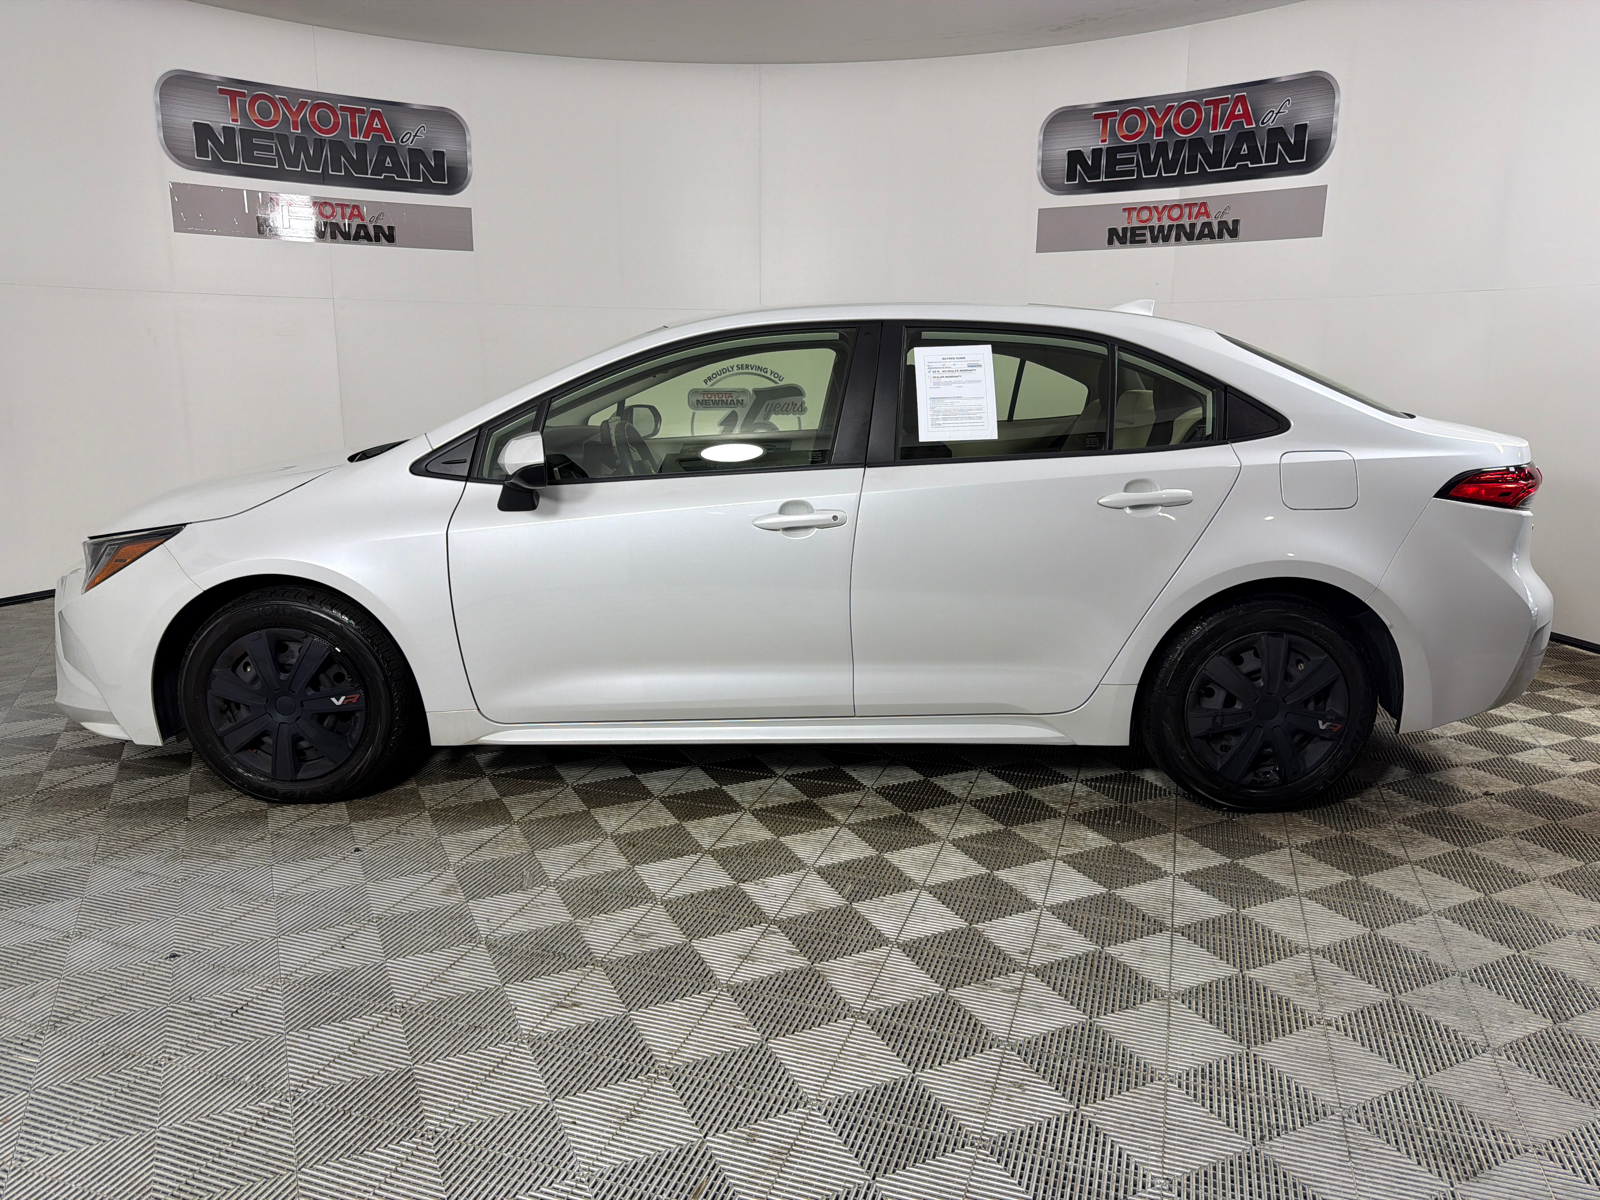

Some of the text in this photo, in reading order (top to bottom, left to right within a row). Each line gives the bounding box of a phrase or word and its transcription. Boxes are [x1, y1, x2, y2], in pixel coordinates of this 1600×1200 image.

[218, 86, 426, 146] TOYOTA of
[1093, 93, 1291, 144] TOYOTA of
[192, 120, 447, 184] NEWNAN
[1065, 122, 1309, 184] NEWNAN
[368, 211, 385, 225] of
[1121, 201, 1231, 225] TOYOTA of
[256, 215, 396, 244] NAN
[1107, 219, 1241, 246] NEWNAN
[703, 364, 785, 385] PROUDLY SERVING YOU
[763, 401, 806, 420] years
